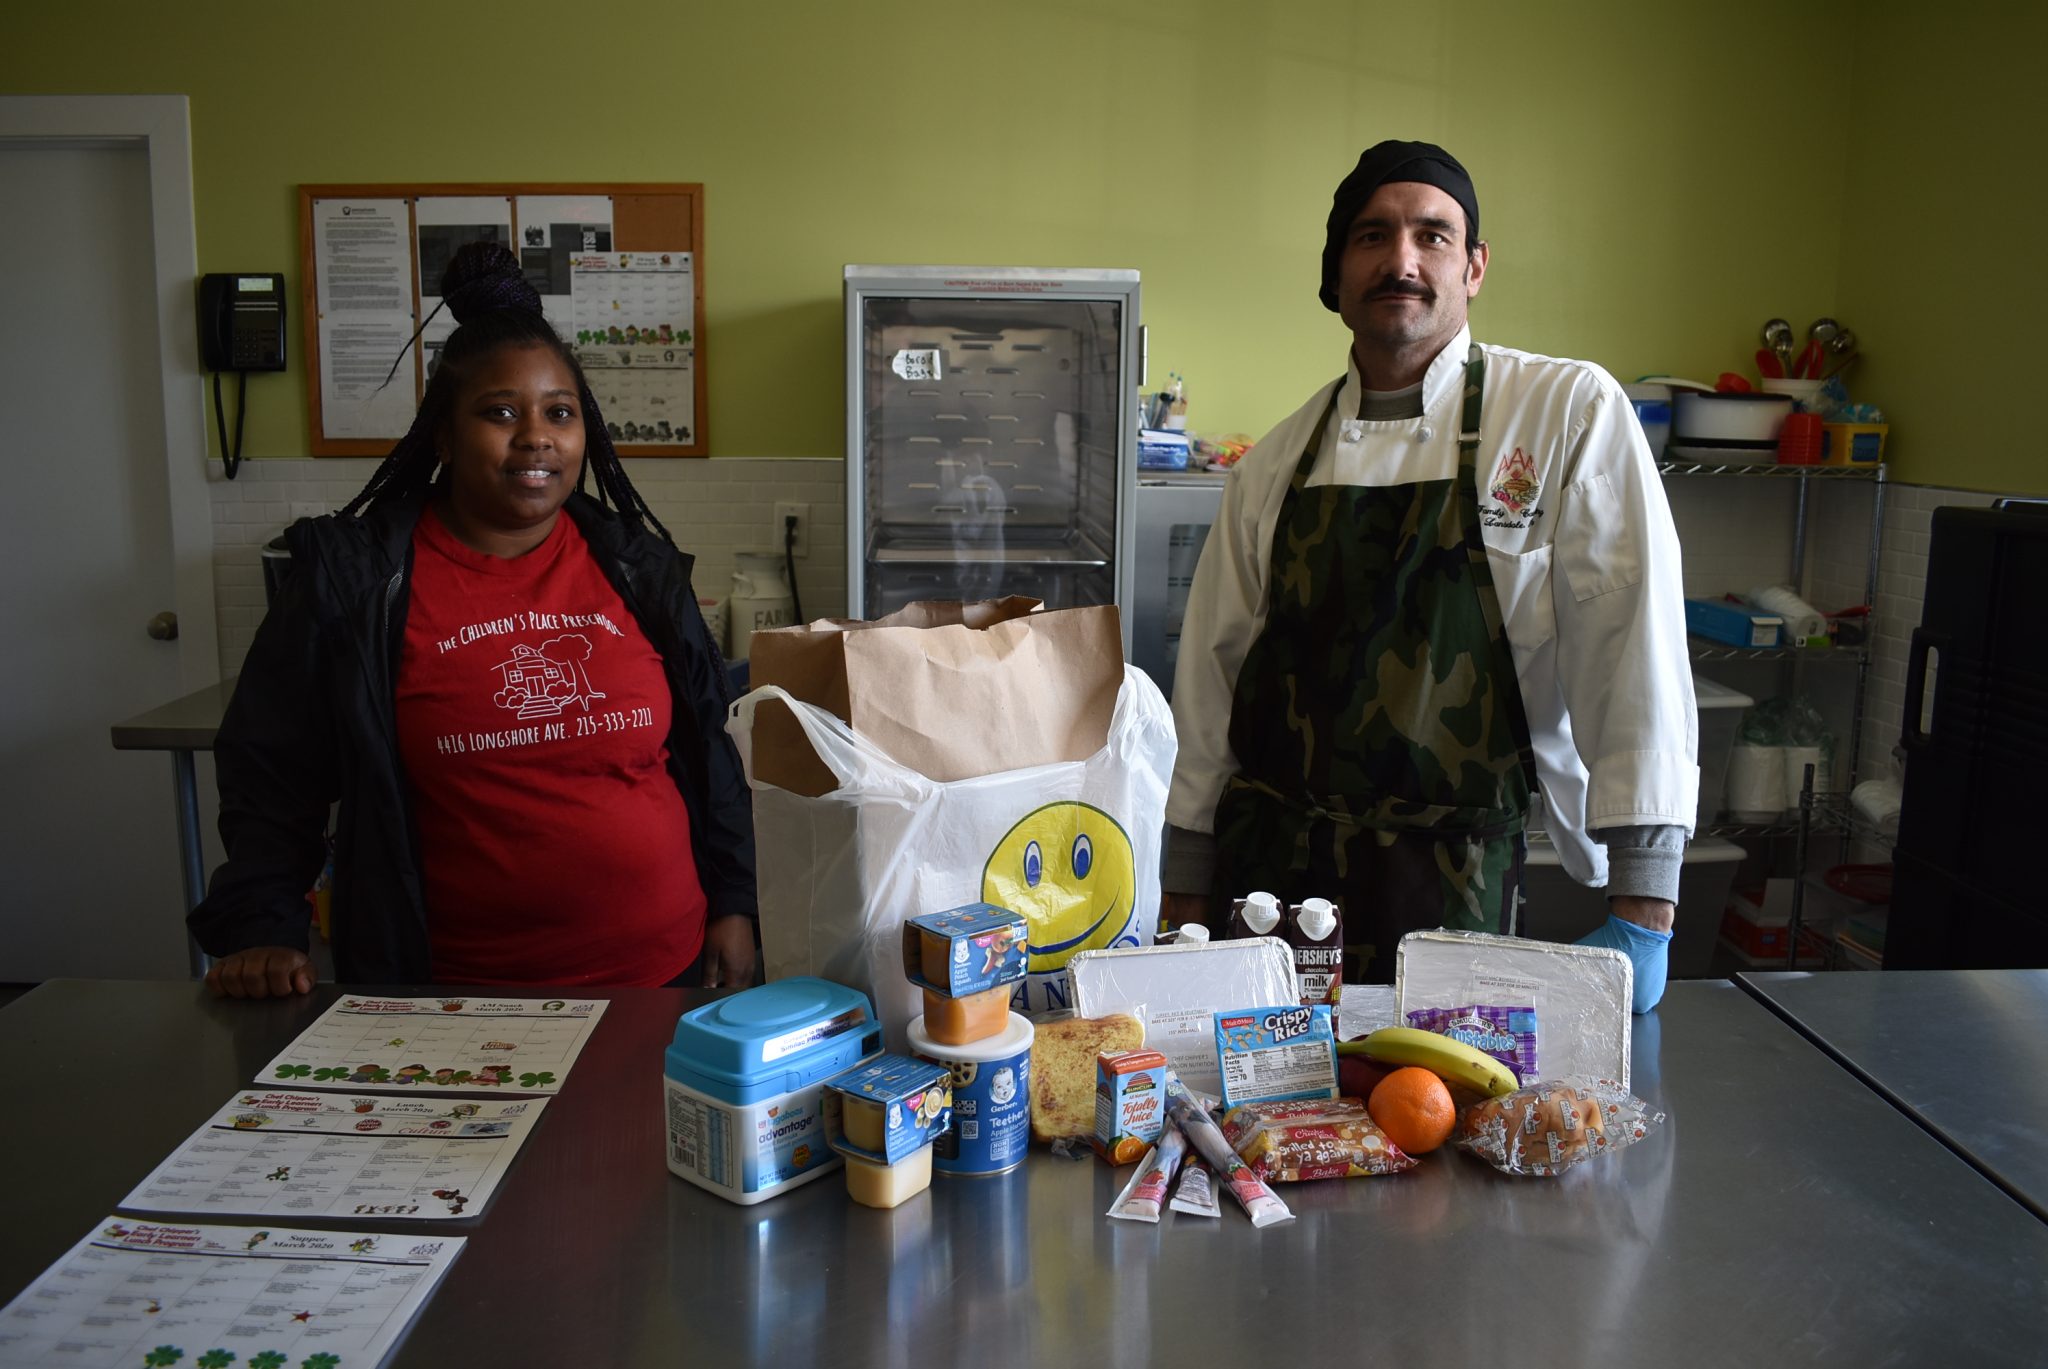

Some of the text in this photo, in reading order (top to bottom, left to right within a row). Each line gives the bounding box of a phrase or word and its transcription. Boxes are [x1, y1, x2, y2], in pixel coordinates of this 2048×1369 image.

[436, 610, 625, 654] THE CHILDREN'S PLACE PRESCHOOL
[436, 707, 654, 755] 4416 LONGSHORE AVE. 215-333-2211
[1304, 975, 1328, 987] milk
[1264, 1006, 1313, 1030] Crispy
[1451, 1016, 1493, 1030] SMUCKER'S
[1273, 1022, 1308, 1042] Rice
[780, 1039, 806, 1053] Similac
[284, 1094, 321, 1102] Chipper's
[281, 1104, 318, 1112] Program
[1122, 1096, 1159, 1116] Totally
[989, 1111, 1025, 1129] Teether
[1122, 1111, 1153, 1128] Juice
[398, 1126, 453, 1136] Culture
[990, 1126, 1009, 1138] Apple
[1278, 1140, 1316, 1156] grilled
[1319, 1141, 1334, 1150] to
[1296, 1147, 1350, 1165] ya again
[1312, 1167, 1340, 1178] Bake
[1370, 1160, 1408, 1176] grilled
[130, 1230, 202, 1242] Early Learners
[136, 1224, 201, 1235] Chef Chipper's
[123, 1235, 195, 1247] Lunch Program
[271, 1241, 335, 1250] March 2020
[289, 1234, 328, 1243] Supper
